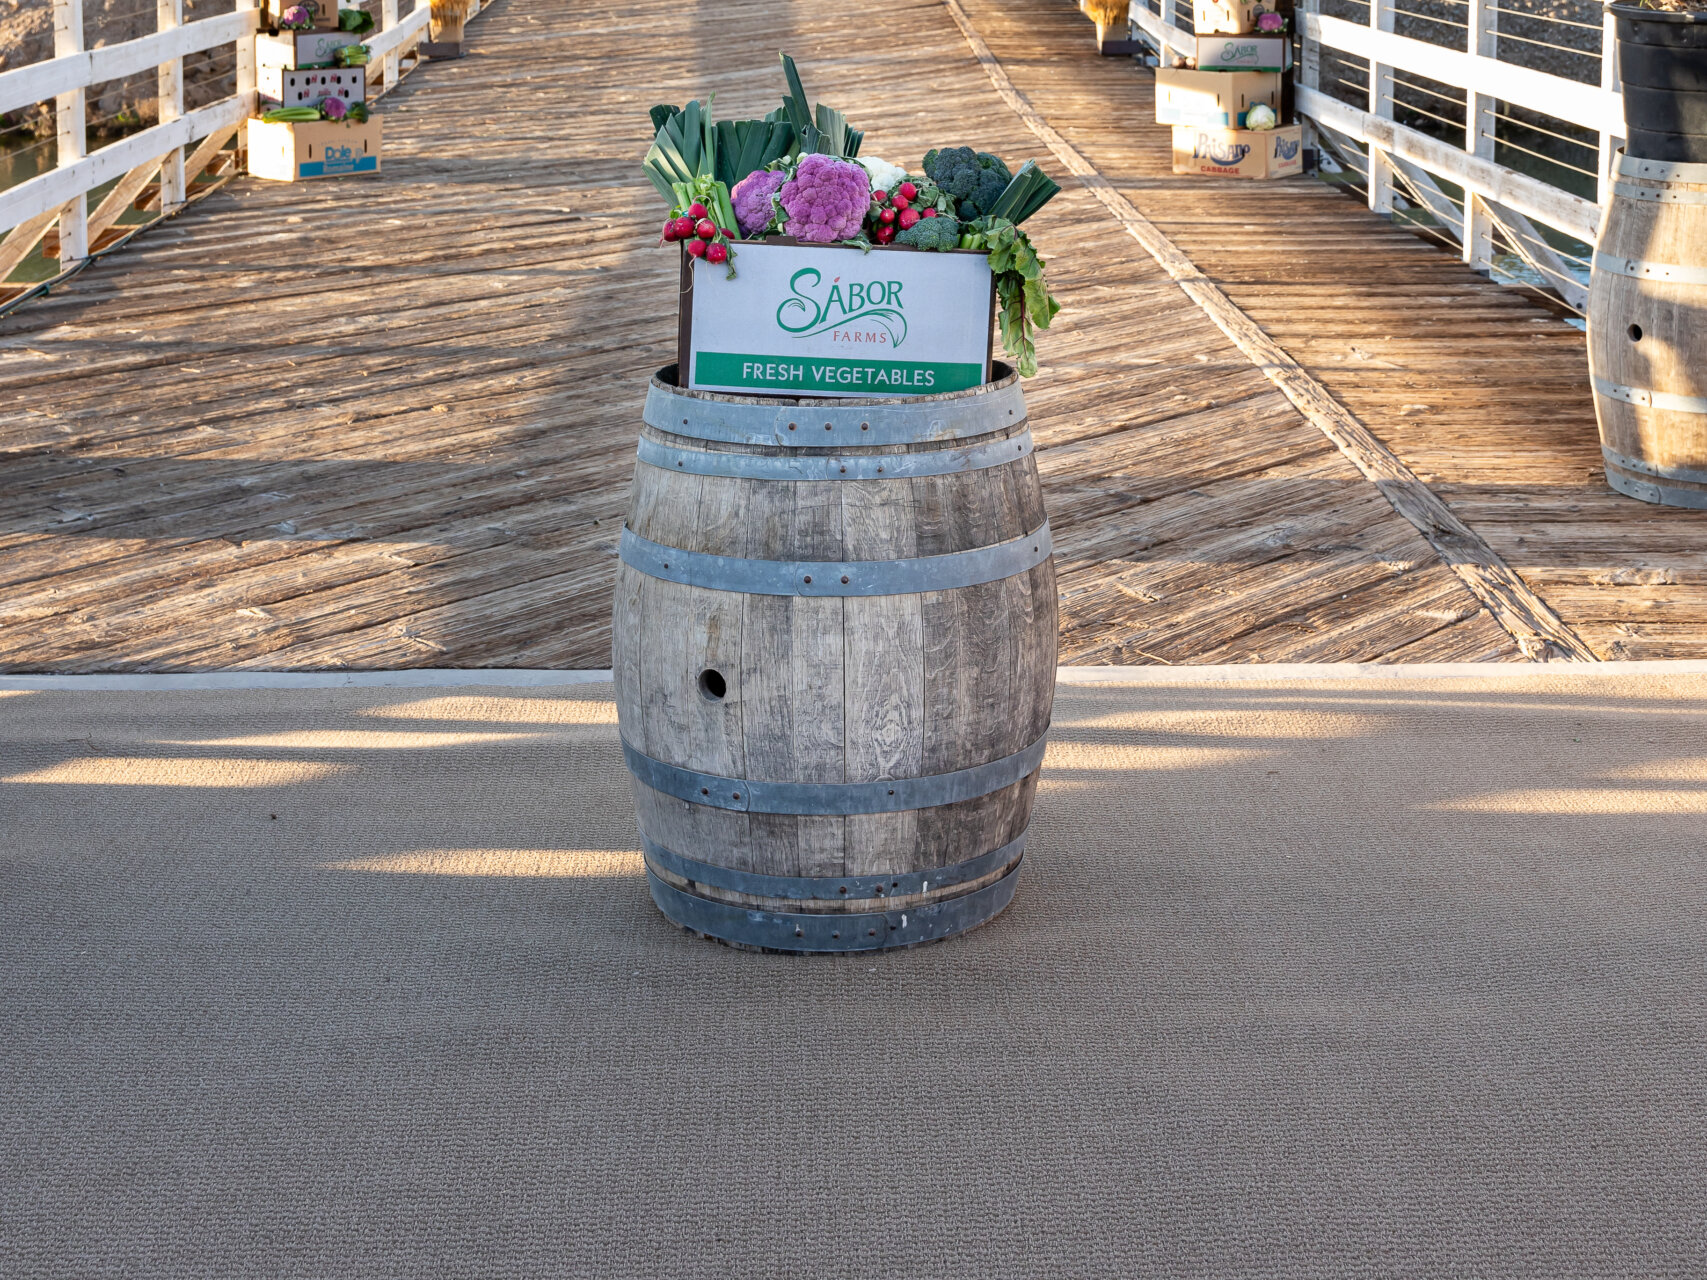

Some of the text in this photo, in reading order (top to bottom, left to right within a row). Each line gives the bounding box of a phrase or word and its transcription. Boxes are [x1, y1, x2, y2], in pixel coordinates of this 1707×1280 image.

[325, 145, 352, 161] Dole
[1200, 165, 1241, 174] CABBAGE
[832, 329, 887, 345] FARMS
[743, 362, 935, 386] FRESH VEGETABLES
